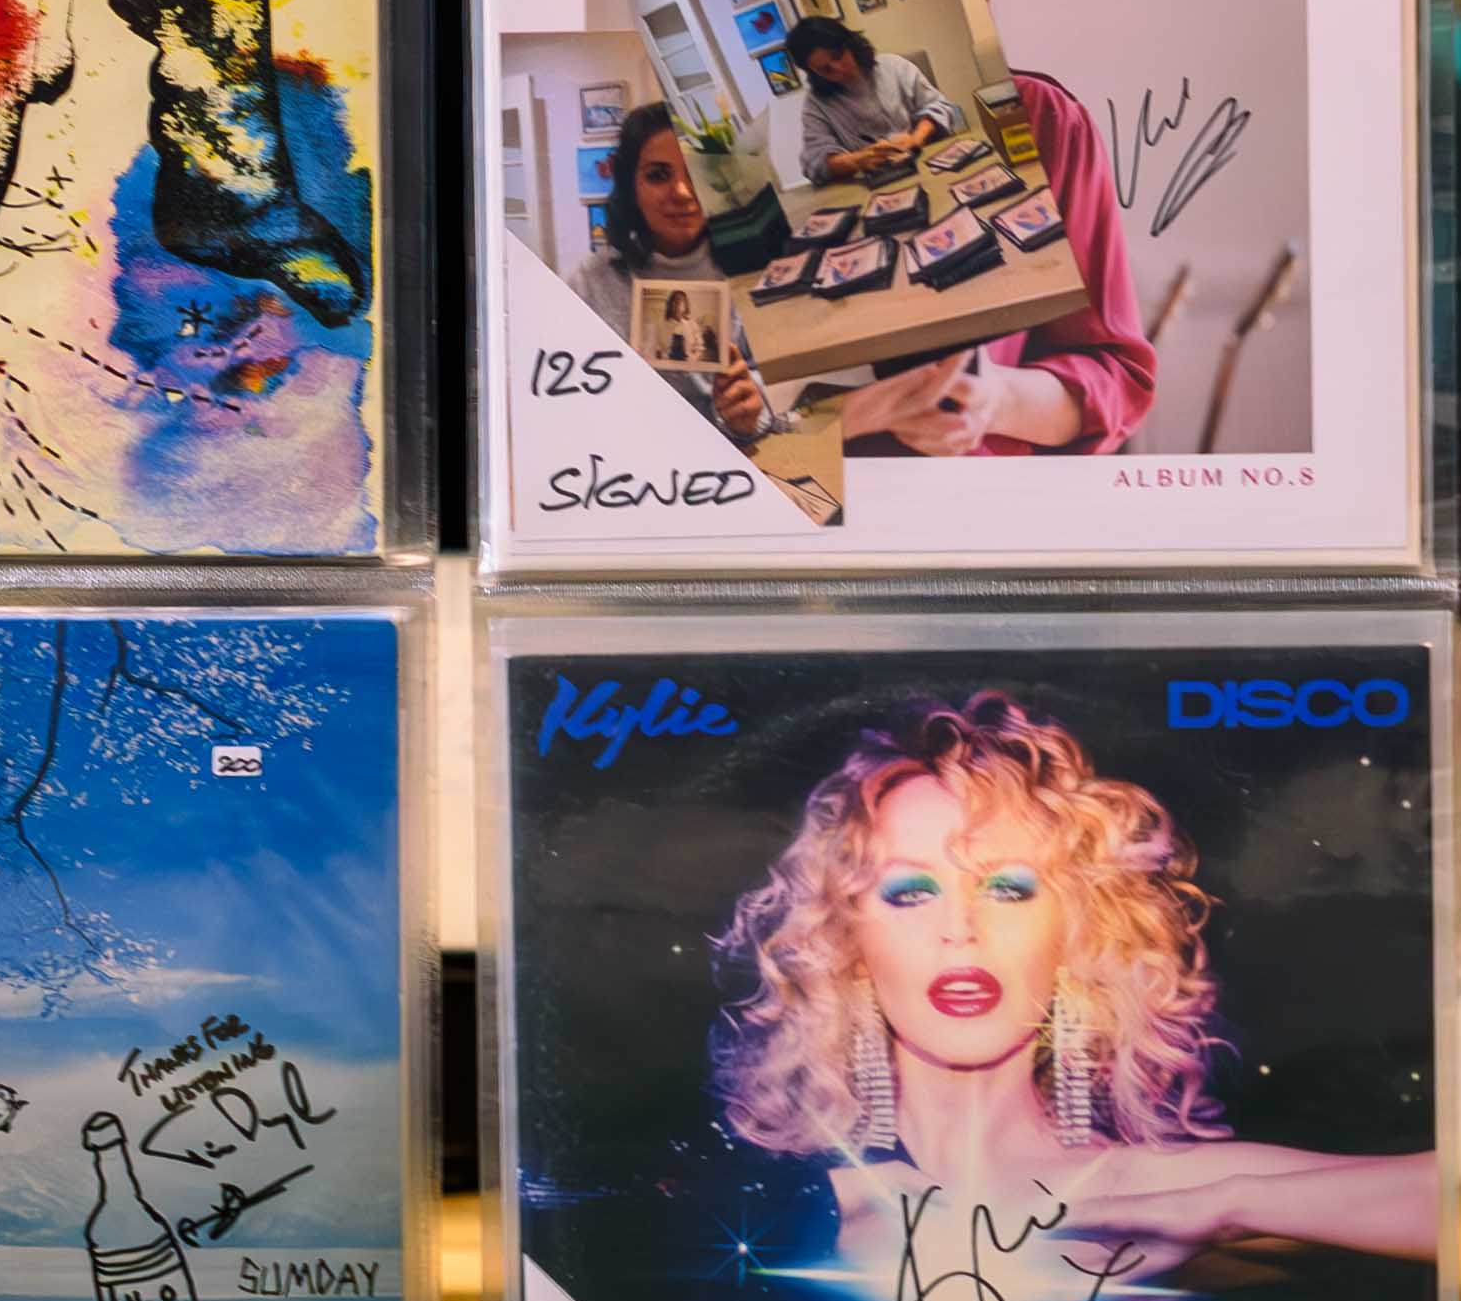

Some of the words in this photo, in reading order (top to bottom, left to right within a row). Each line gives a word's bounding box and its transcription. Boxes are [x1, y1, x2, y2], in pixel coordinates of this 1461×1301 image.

[530, 349, 624, 399] 125
[1112, 466, 1225, 490] ALBUM
[1240, 465, 1317, 489] NO.8
[540, 674, 739, 770] Kylie
[1166, 679, 1410, 730] DISCO
[237, 1256, 381, 1299] SUMDAY
